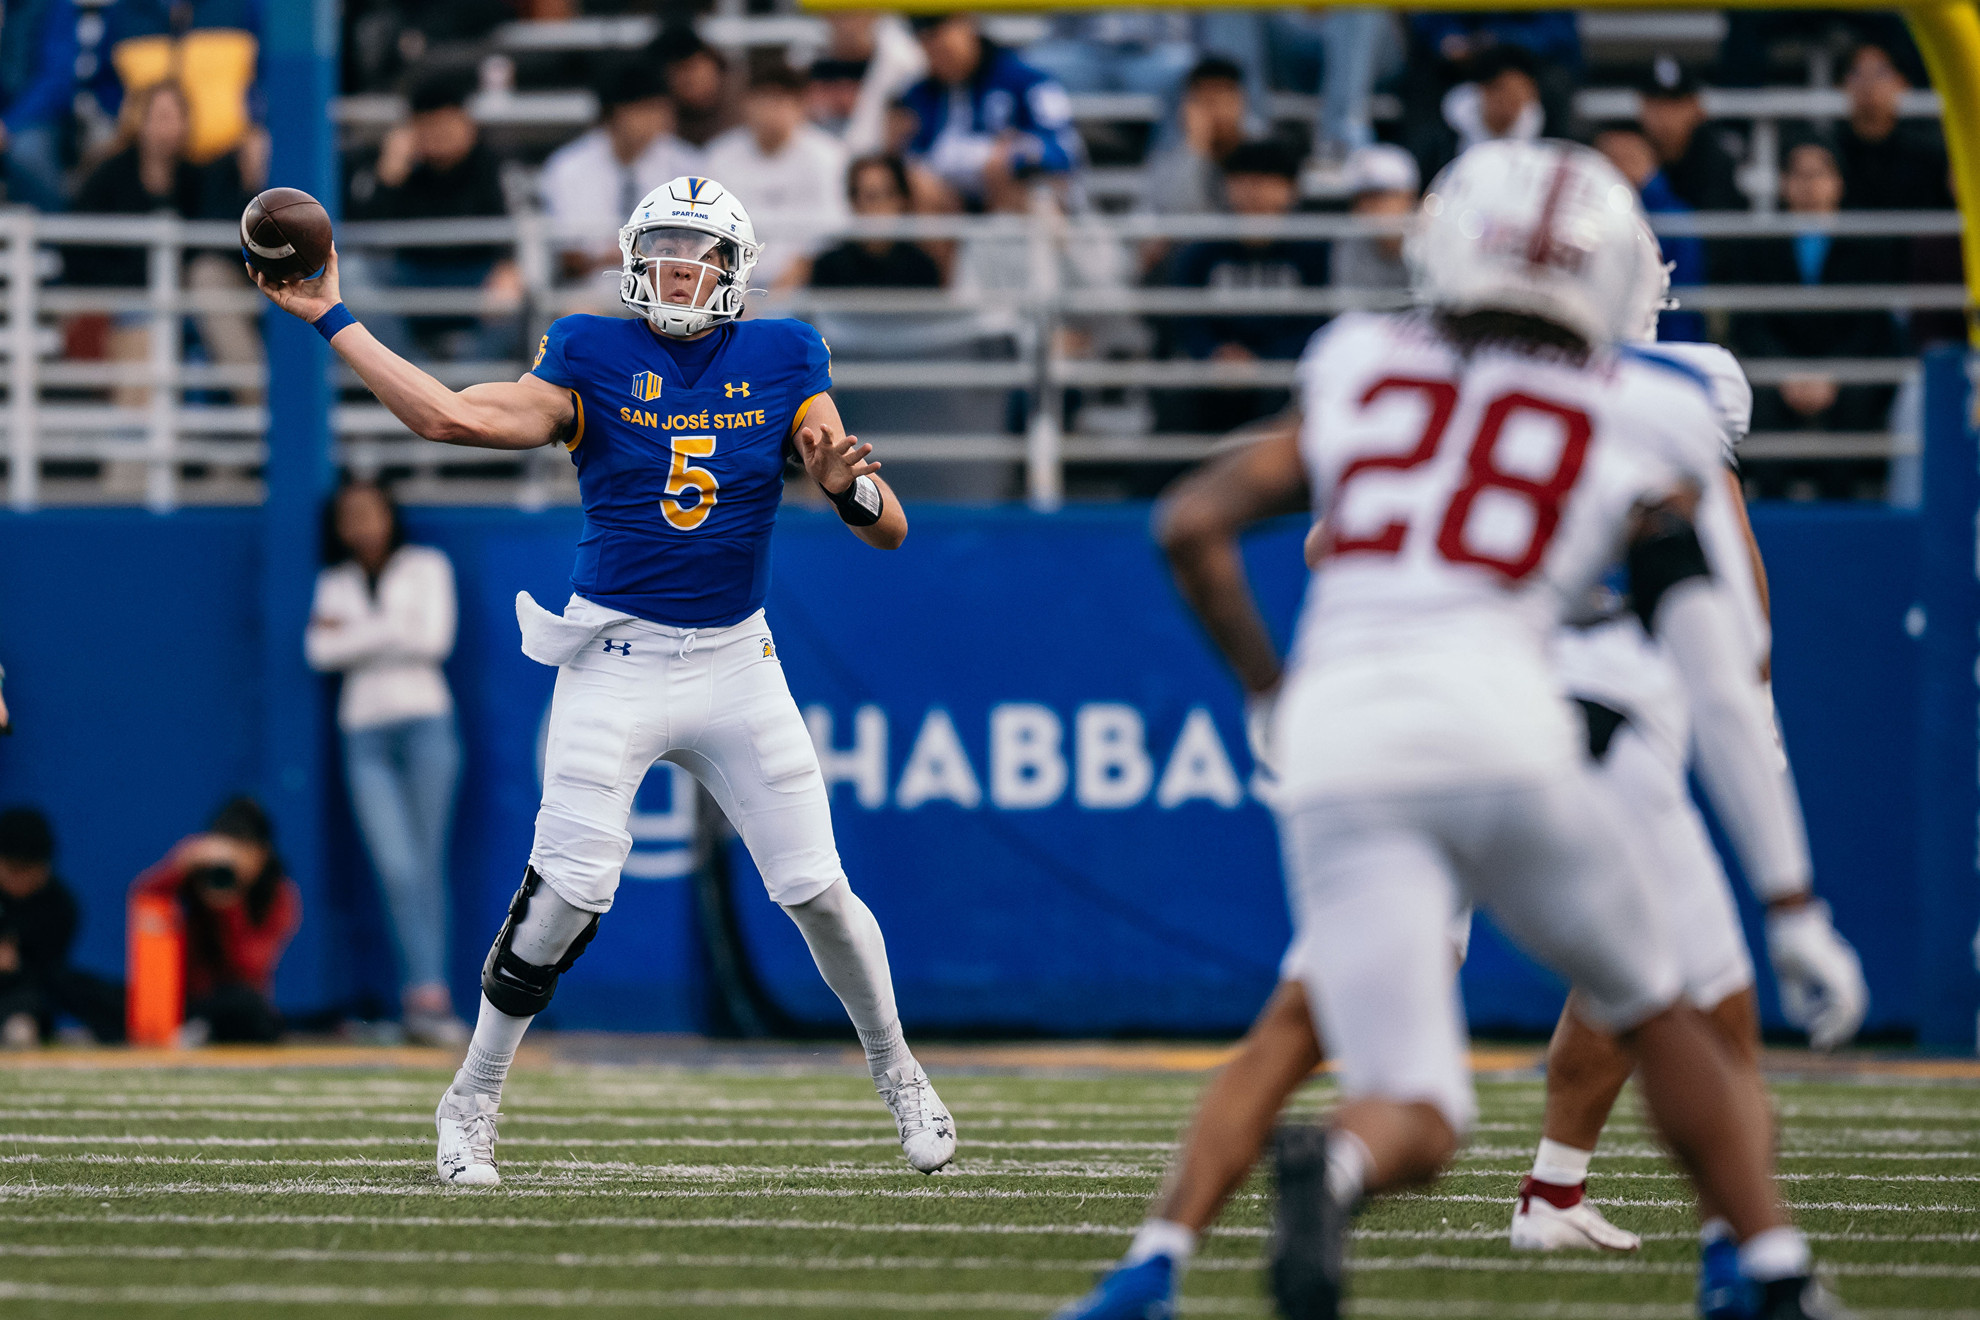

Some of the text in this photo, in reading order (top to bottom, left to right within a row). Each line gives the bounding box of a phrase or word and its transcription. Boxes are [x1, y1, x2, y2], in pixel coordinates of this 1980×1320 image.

[672, 211, 709, 220] SPARTANS
[619, 406, 766, 431] SAN JOSÉ STATE
[659, 435, 720, 531] 5
[1327, 373, 1593, 582] 28
